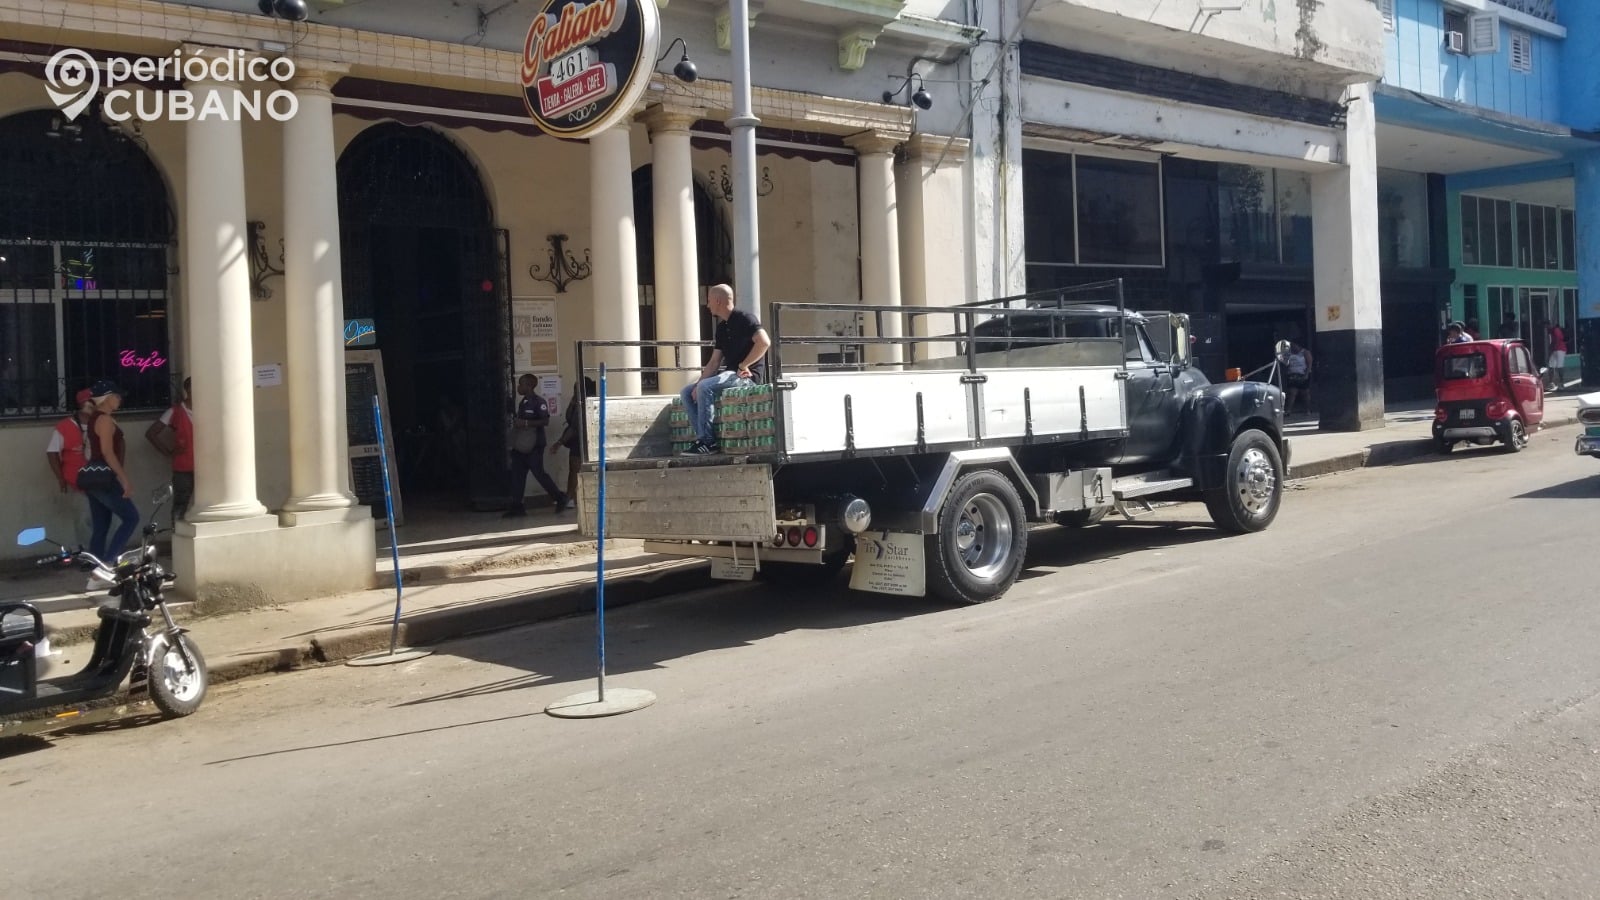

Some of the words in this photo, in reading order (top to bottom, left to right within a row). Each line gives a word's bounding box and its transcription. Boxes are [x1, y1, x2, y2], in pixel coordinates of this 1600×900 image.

[521, 0, 618, 86] Galiano
[556, 52, 585, 82] 461
[343, 320, 374, 343] Open
[886, 542, 909, 556] Star
